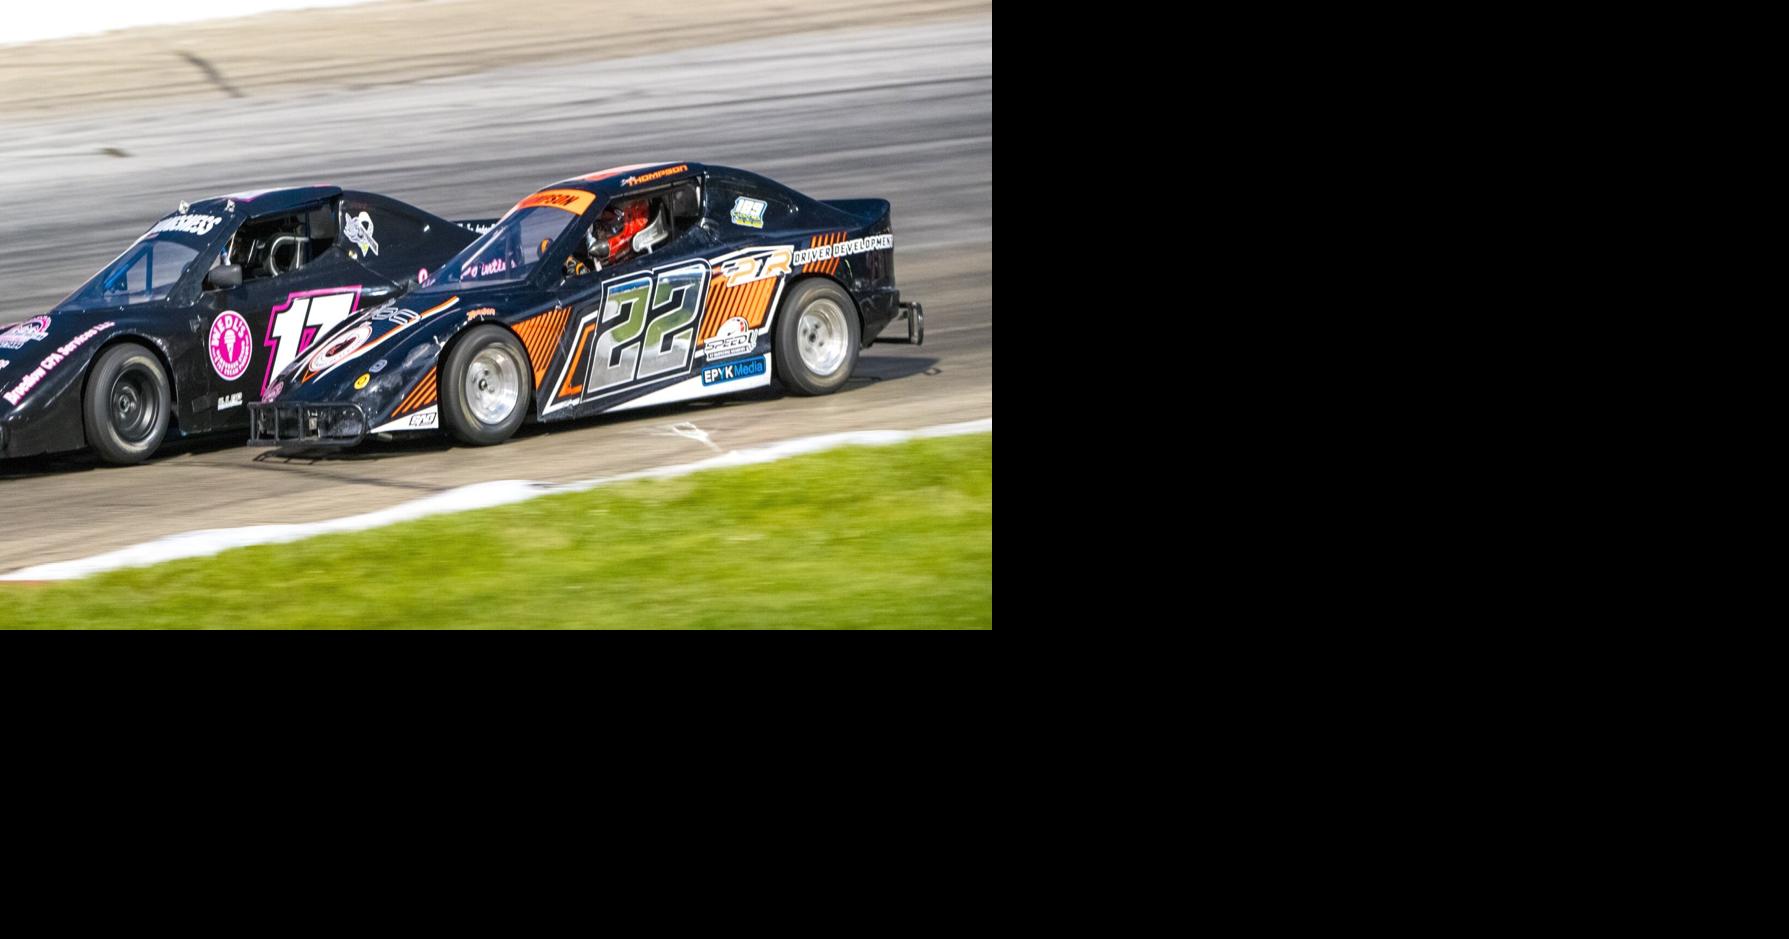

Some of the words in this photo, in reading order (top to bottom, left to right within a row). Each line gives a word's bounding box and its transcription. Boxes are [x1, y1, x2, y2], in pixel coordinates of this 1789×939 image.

[628, 164, 688, 187] THOMPSON
[793, 246, 831, 266] DRIVER
[833, 235, 893, 257] DEVELOPMEN
[211, 315, 246, 347] WEDL'S
[265, 286, 358, 394] 17
[584, 260, 708, 397] 22
[40, 352, 64, 370] CPA
[57, 329, 98, 356] Services
[704, 365, 734, 383] EPYK
[734, 359, 763, 377] Media
